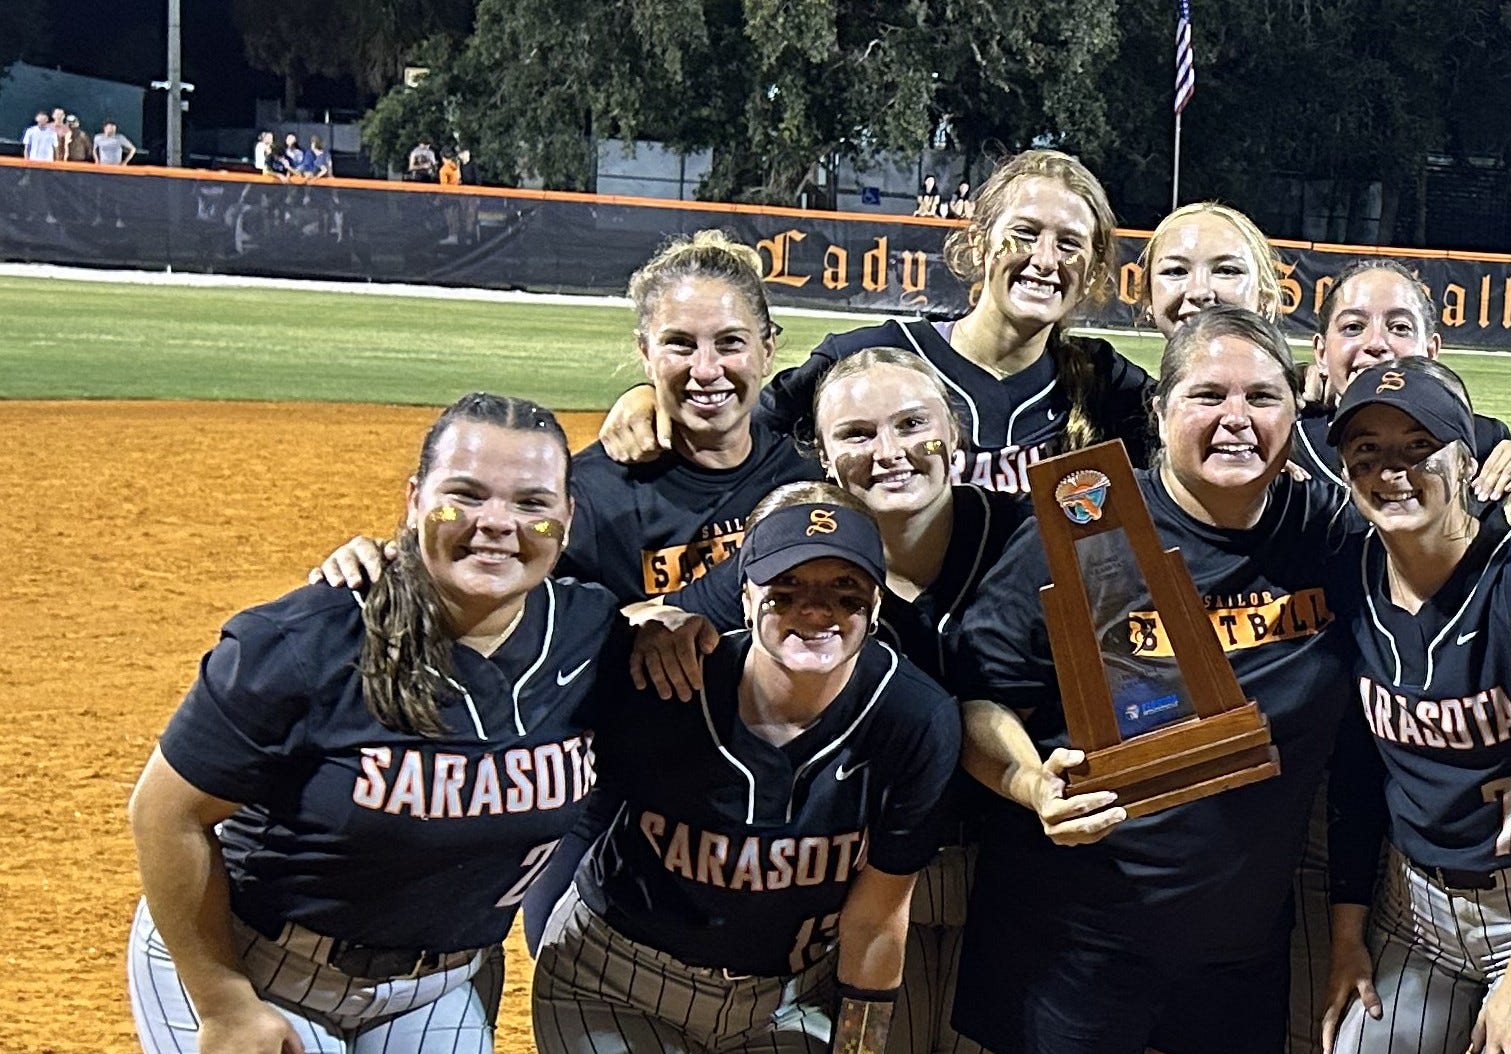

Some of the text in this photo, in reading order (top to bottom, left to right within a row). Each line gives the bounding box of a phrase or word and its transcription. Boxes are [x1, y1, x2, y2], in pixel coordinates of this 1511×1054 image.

[756, 229, 928, 305] Lady
[1375, 371, 1406, 394] S
[701, 516, 750, 539] SAIL
[806, 509, 839, 537] S
[1203, 591, 1274, 609] SAILOR
